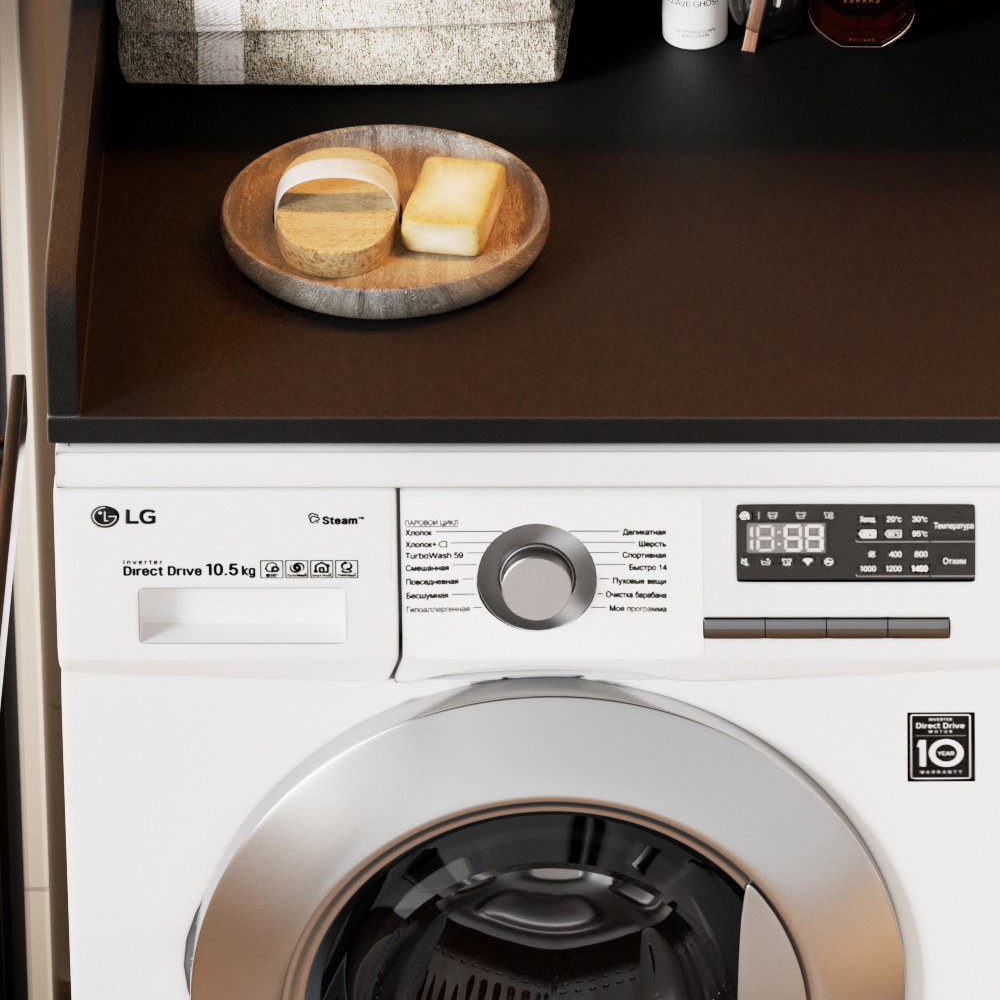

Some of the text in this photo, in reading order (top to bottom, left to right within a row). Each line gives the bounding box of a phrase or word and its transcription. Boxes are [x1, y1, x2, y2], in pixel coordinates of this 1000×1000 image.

[125, 509, 156, 525] LG
[933, 521, 975, 531] Температура
[622, 529, 667, 537] Деликатная
[622, 551, 667, 560] Спортивная
[889, 550, 902, 558] 400
[913, 550, 928, 558] 800
[942, 557, 967, 565] Отжим
[123, 566, 163, 576] Direct
[167, 566, 202, 576] Drive
[206, 563, 238, 576] 10.5
[241, 566, 256, 578] kg
[405, 564, 449, 572] Смешанная
[628, 563, 668, 572] Быстро 14
[860, 565, 877, 573] 1000
[886, 565, 902, 573] 1200
[405, 578, 459, 586] Повседневная
[612, 578, 667, 586] Пуховые вещи
[406, 592, 449, 600] Бесшумная
[605, 591, 668, 600] Очистка барабана
[406, 606, 471, 614] Гипоаллергенная
[915, 722, 966, 730] Direct Drive
[916, 738, 965, 768] 10
